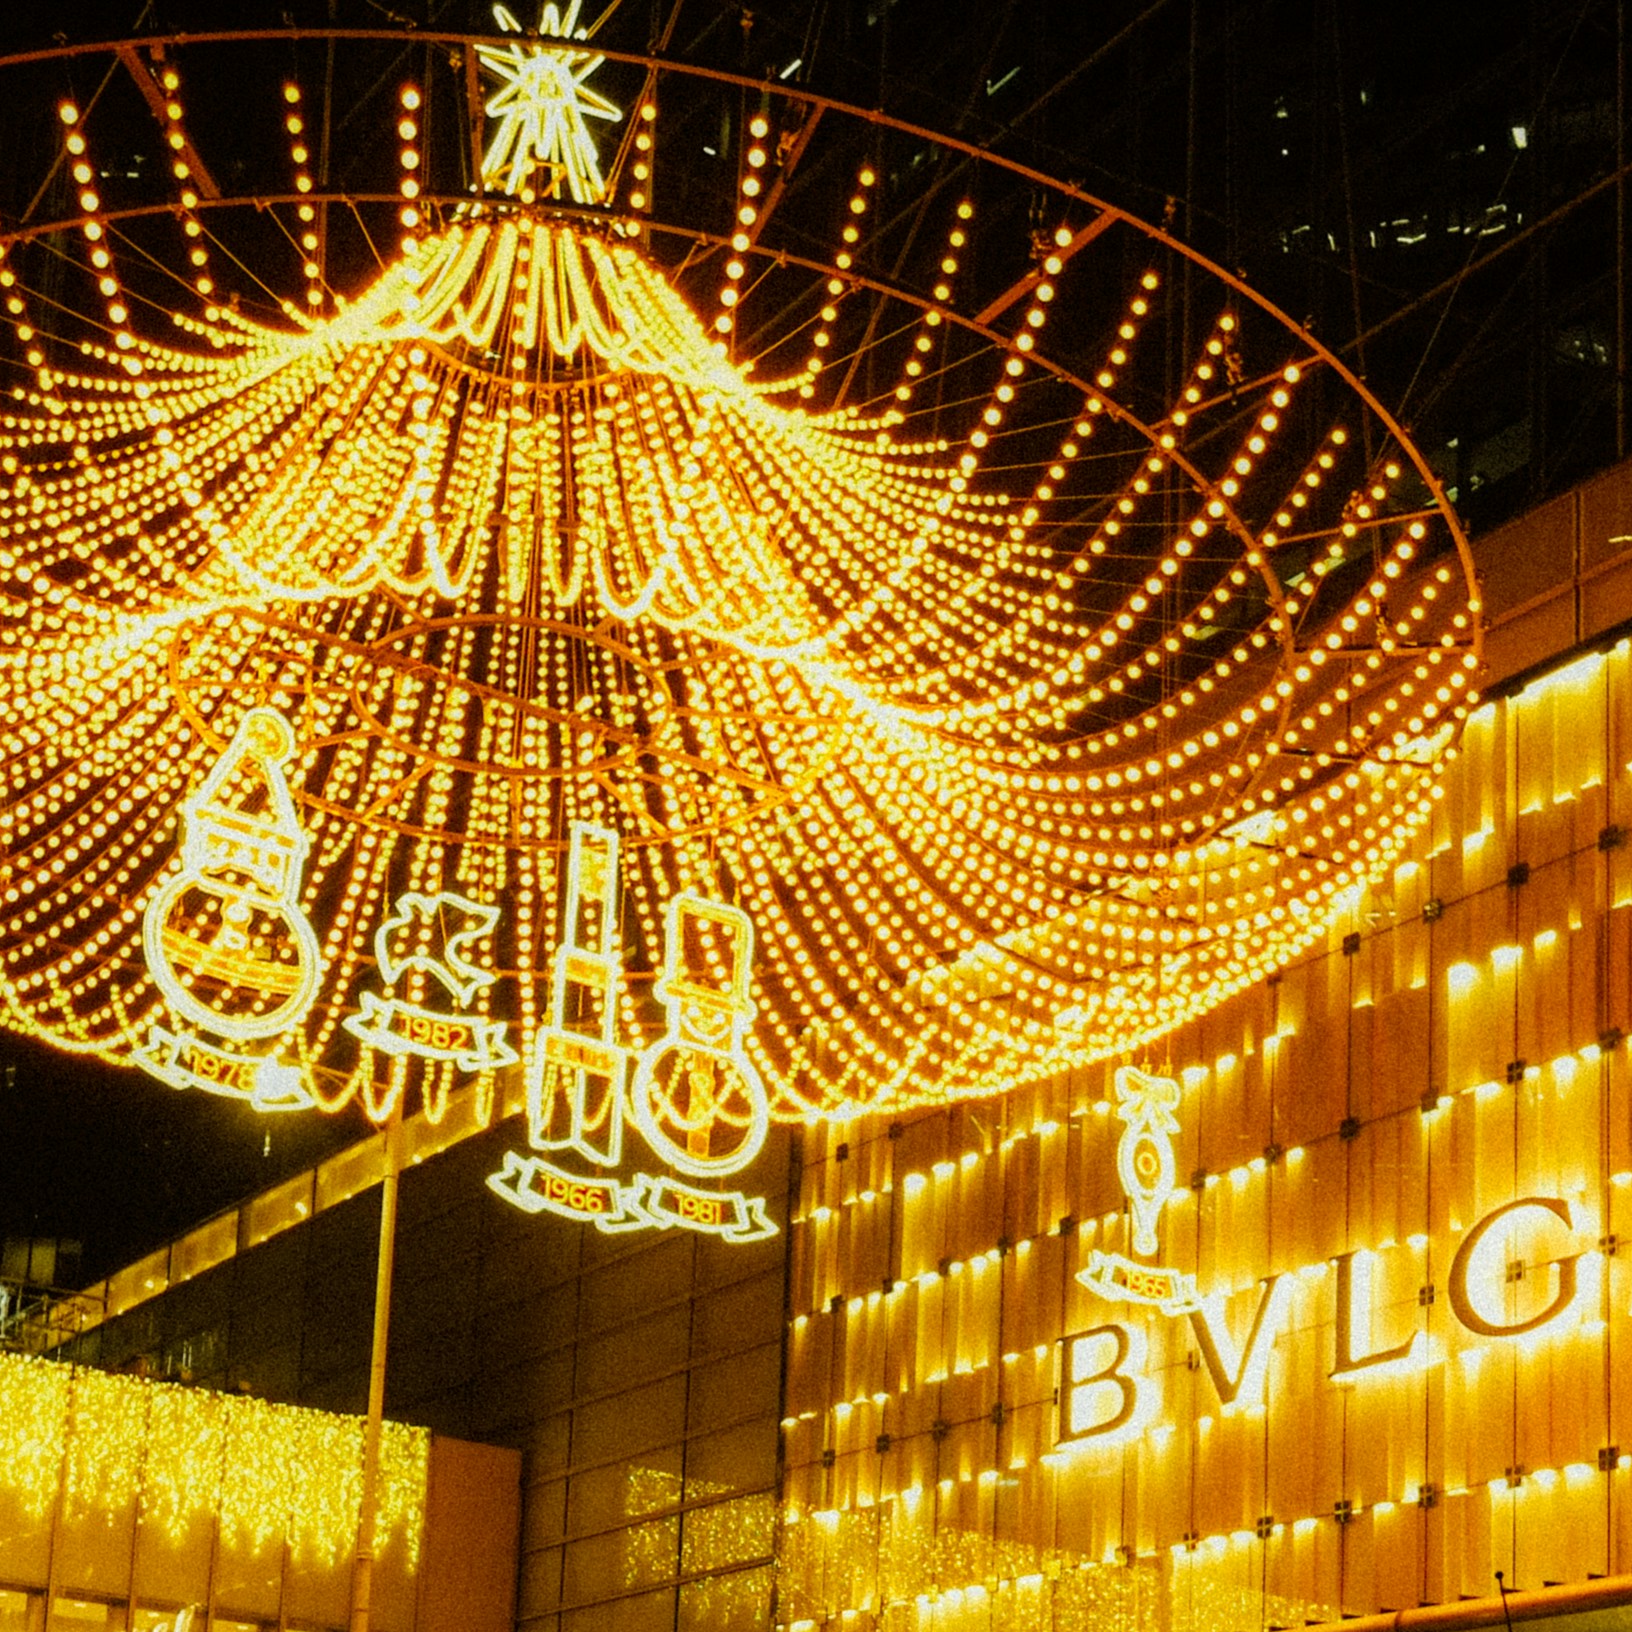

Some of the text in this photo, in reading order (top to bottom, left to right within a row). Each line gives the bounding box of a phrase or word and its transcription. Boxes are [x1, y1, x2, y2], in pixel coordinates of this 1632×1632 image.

[401, 1016, 468, 1051] 1982
[541, 1175, 604, 1214] 1966
[675, 1192, 722, 1225] 1981
